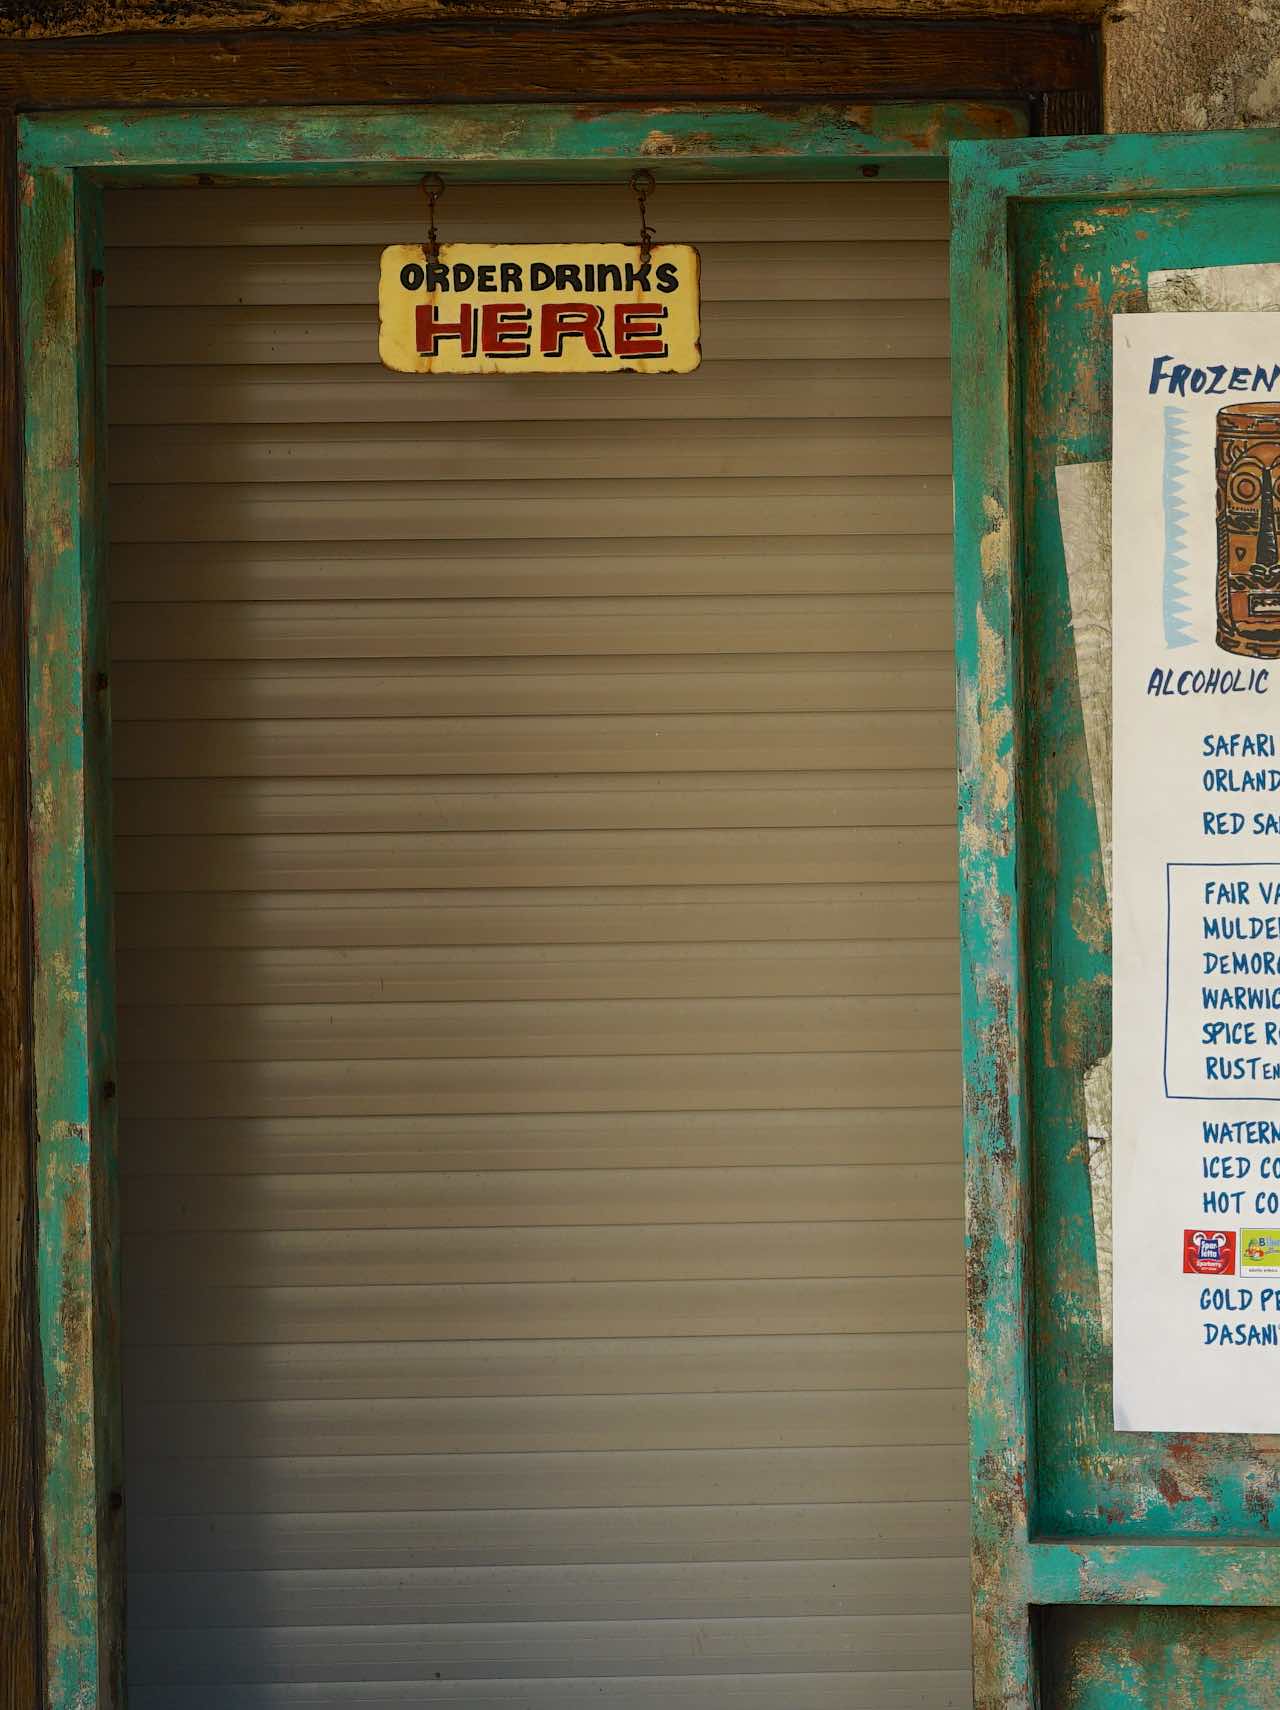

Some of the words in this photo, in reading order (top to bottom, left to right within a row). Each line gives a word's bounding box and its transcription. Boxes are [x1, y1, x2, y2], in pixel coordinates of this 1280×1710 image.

[400, 263, 523, 293] ORDER
[415, 303, 669, 359] HERE
[1146, 668, 1269, 697] ALCOHOLIC
[1203, 733, 1275, 757] SAFARI
[1203, 812, 1245, 835] RED
[1205, 882, 1249, 905] FAIR
[1202, 1022, 1257, 1046] SPICE
[1203, 1156, 1250, 1179] ICED
[1203, 1191, 1246, 1214] HOT
[1200, 1288, 1252, 1311] GOLD
